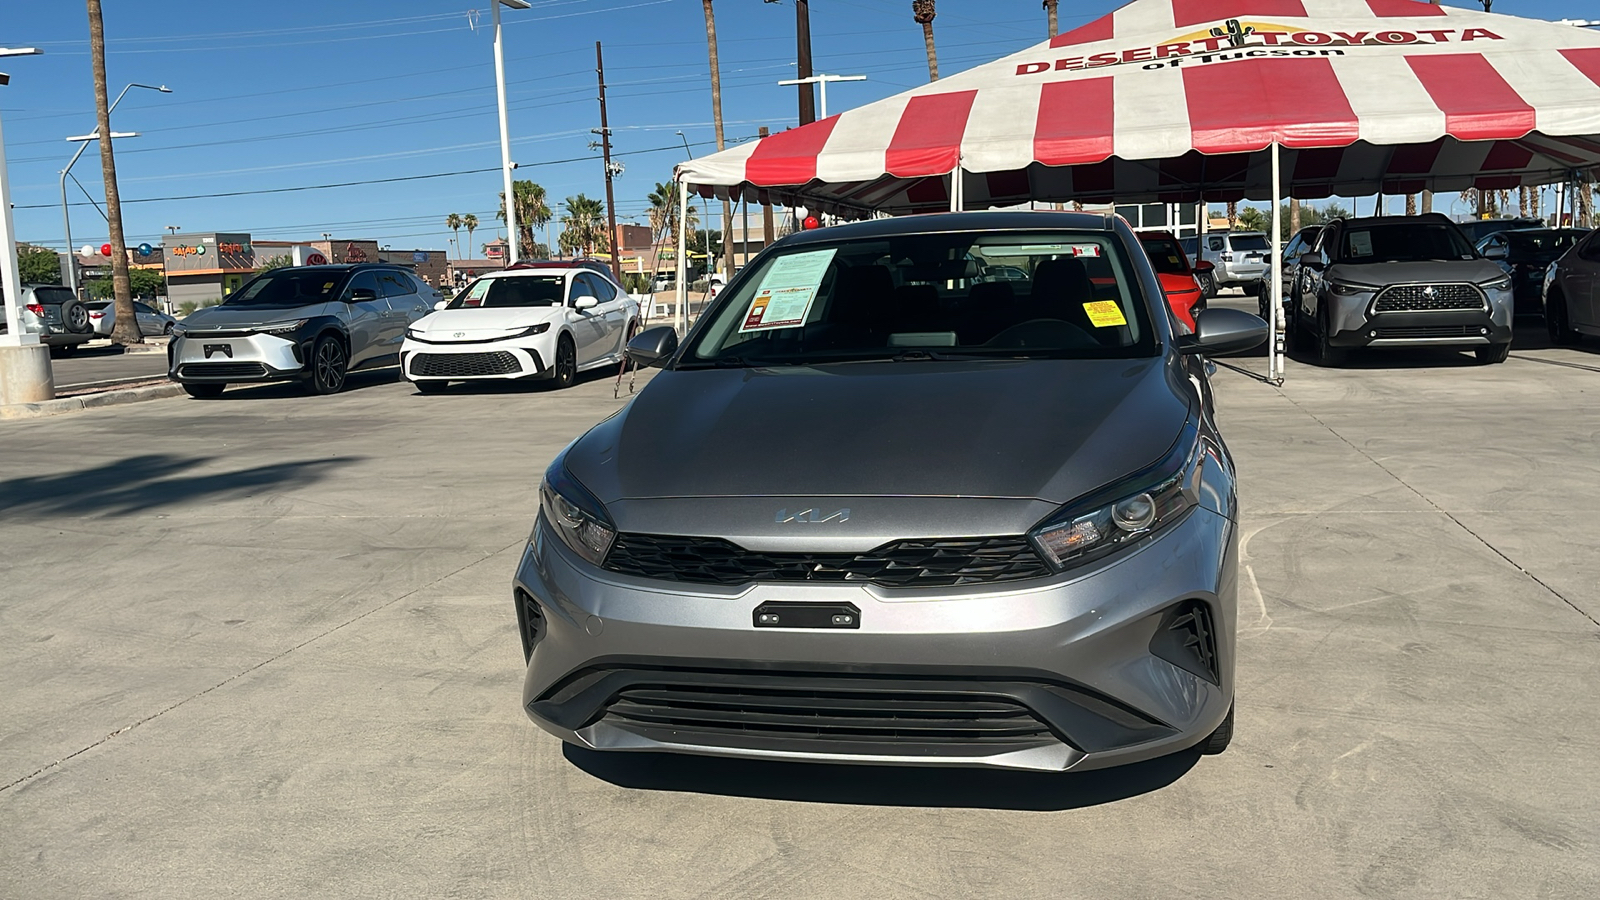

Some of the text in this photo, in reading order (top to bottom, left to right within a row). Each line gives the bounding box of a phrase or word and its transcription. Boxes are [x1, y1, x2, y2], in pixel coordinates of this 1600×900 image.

[1016, 28, 1506, 76] DESERT TOYOTA
[1142, 49, 1345, 71] of Tucson
[775, 507, 851, 523] KIA
